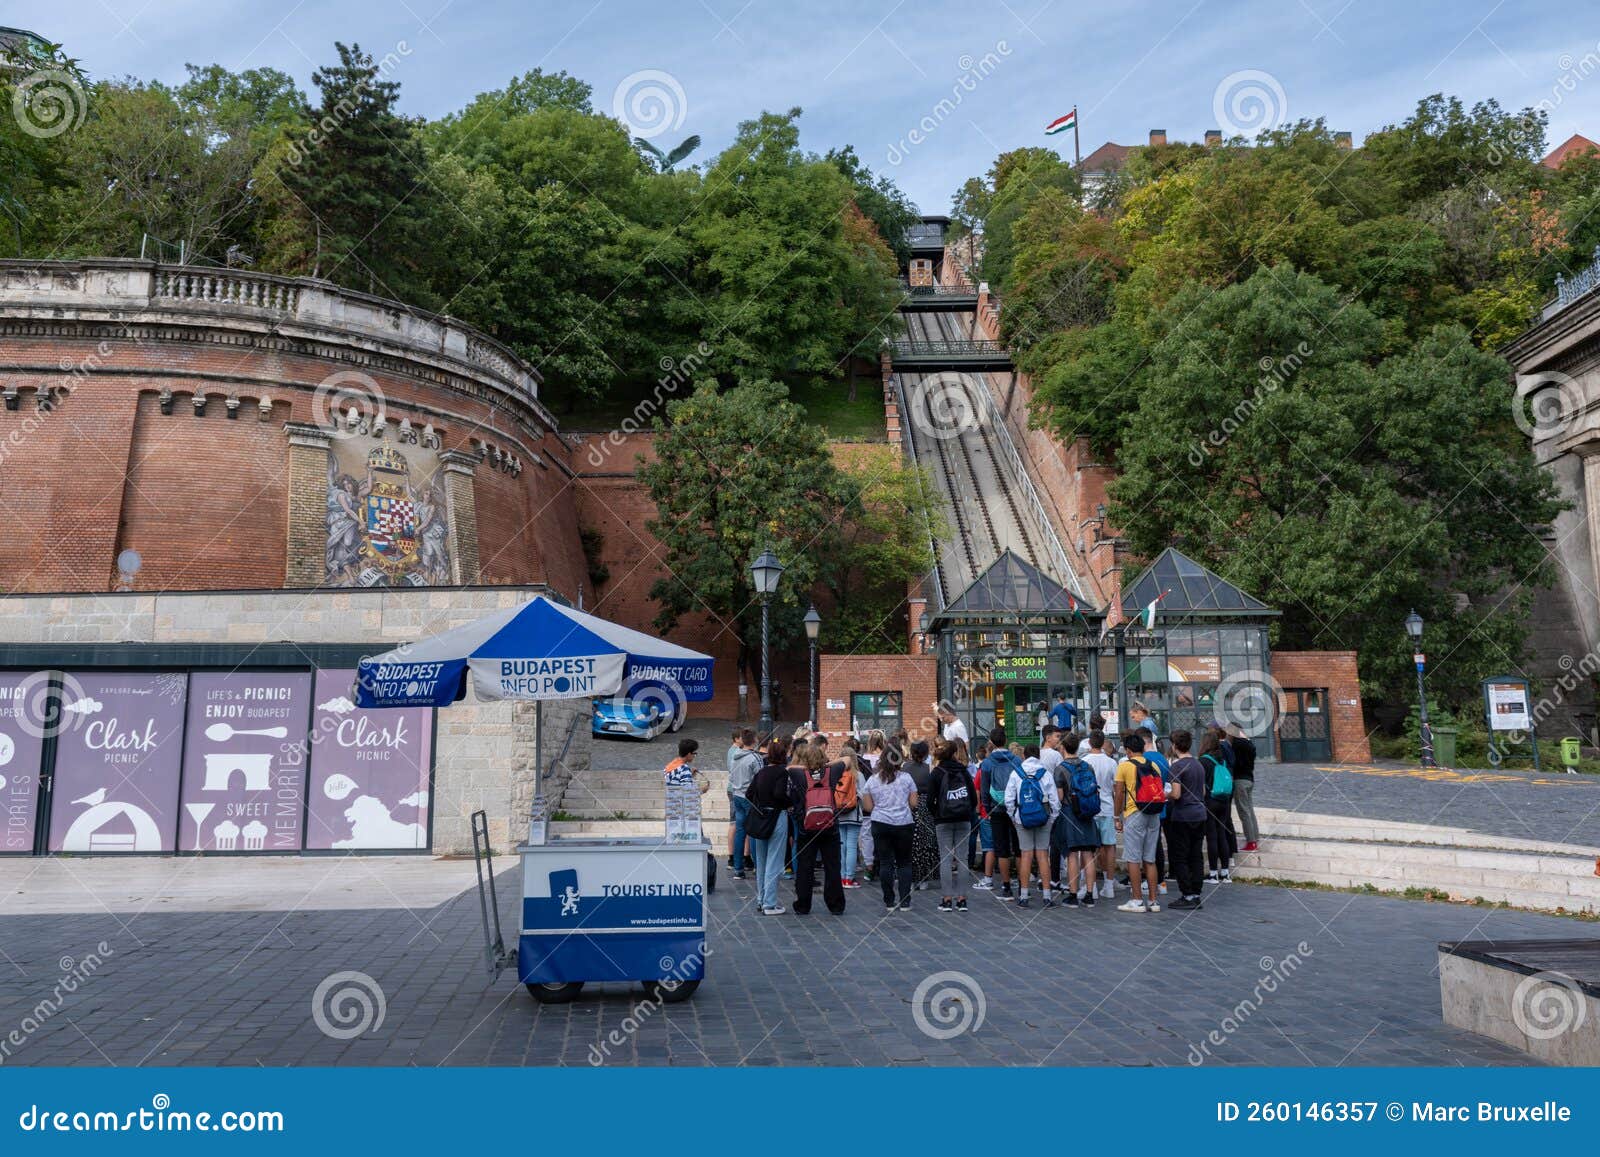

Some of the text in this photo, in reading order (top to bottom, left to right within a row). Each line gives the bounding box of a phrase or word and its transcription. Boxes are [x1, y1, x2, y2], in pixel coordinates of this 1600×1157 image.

[501, 659, 596, 676] BUDAPEST
[1011, 657, 1035, 667] 3000
[1037, 657, 1046, 667] H
[376, 664, 444, 680] BUDAPEST
[631, 664, 708, 681] BUDAPEST CARD
[207, 690, 233, 700] LIFE'S
[244, 687, 291, 700] PICNIC!
[206, 704, 290, 718] ENJOY BUDAPEST
[85, 717, 158, 752] Clark
[337, 716, 408, 749] Clark
[104, 752, 139, 764] PICNIC
[356, 750, 391, 761] PICNIC
[273, 742, 300, 847] MEMORIES
[7, 775, 32, 847] STORIES
[226, 802, 270, 817] SWEET
[602, 883, 704, 898] TOURIST INFO
[630, 917, 698, 926] www.budapestinfo.hu
